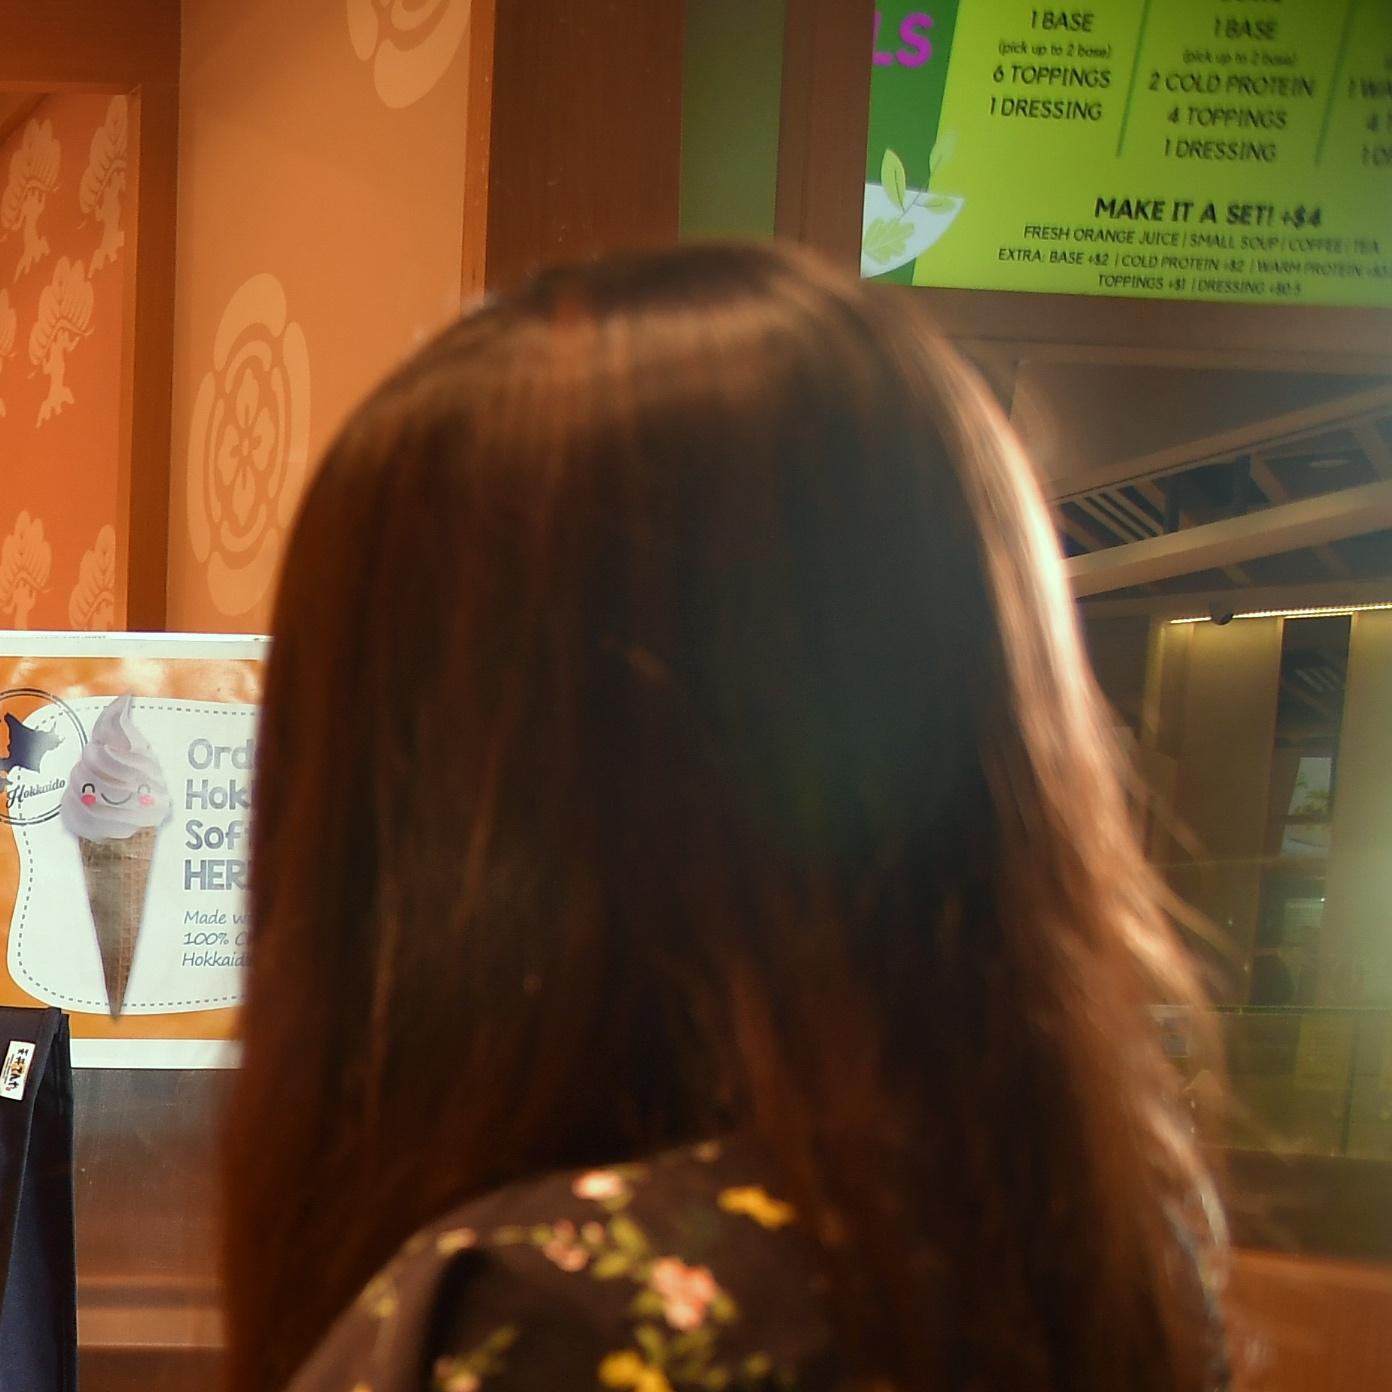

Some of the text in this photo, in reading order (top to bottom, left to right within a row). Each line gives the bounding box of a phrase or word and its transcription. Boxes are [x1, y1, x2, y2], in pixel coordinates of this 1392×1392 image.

[1042, 12, 1094, 33] BASE
[1225, 19, 1279, 41] BASE
[992, 65, 1112, 89] 6 TOPPINGS
[1148, 72, 1314, 98] 2 COLD PROTEIN
[1001, 98, 1103, 122] DRESSING
[1167, 105, 1288, 130] 4 TOPPINGS
[1176, 140, 1277, 163] DRESSING
[1094, 197, 1164, 222] MAKE
[1171, 200, 1195, 223] IT
[1199, 202, 1217, 224] A
[1226, 204, 1274, 226] SET!
[1023, 225, 1070, 242] FRESH
[1073, 228, 1134, 245] ORANGE
[1138, 230, 1180, 247] JUICE
[1189, 232, 1236, 250] SMALL
[1240, 234, 1279, 252] SOUP
[998, 248, 1045, 264] EXTRA:
[1049, 250, 1083, 266] BASE
[1121, 254, 1158, 270] COLD
[1161, 256, 1220, 272] PROTEIN
[1098, 273, 1164, 291] TOPPINGS
[1196, 278, 1266, 296] DRESSING
[6, 778, 66, 809] Hokkaido
[183, 909, 228, 926] Made
[182, 931, 230, 947] 100%
